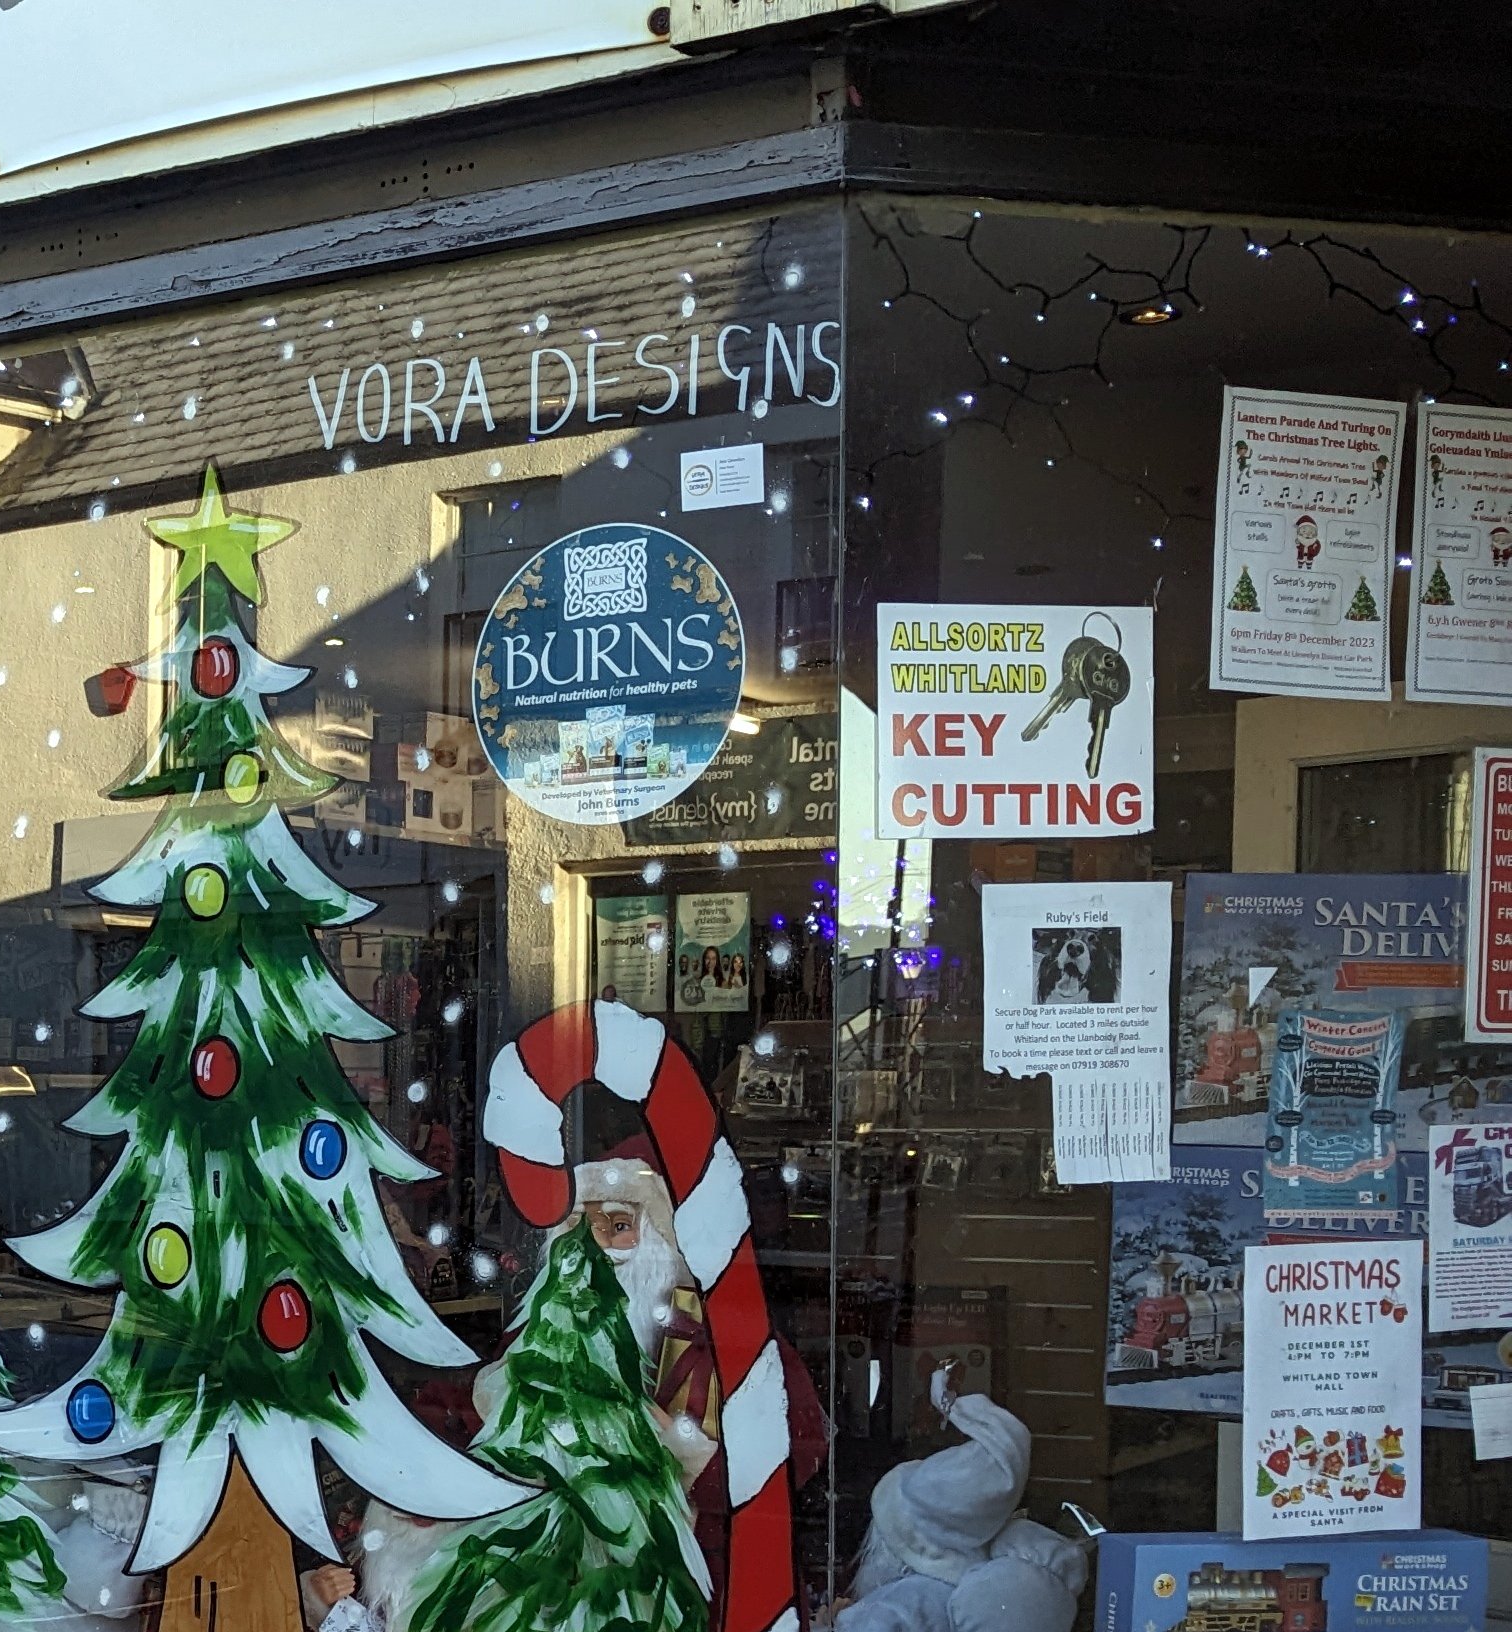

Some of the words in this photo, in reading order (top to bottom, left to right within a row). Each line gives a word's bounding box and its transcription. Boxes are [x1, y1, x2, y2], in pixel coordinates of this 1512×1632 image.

[308, 356, 495, 450] VORA
[529, 321, 842, 435] DESIGNS
[1237, 411, 1277, 425] Lantern
[1280, 416, 1315, 429] Parade
[1318, 420, 1338, 431] And
[1341, 421, 1375, 437] Turing
[1378, 425, 1391, 435] On
[1246, 429, 1265, 441] The
[1268, 432, 1319, 446] Christmas
[1321, 436, 1345, 448] Tree
[1347, 439, 1380, 452] Lights.
[1432, 427, 1490, 440] Gorymdaith
[1430, 443, 1482, 456] Goleuadau
[1273, 575, 1306, 587] Santa's
[1307, 580, 1337, 591] grotto
[1468, 574, 1492, 586] Groto
[1452, 616, 1487, 628] Gwener
[891, 621, 1044, 653] ALLSORTZ
[1230, 627, 1251, 639] 6pm
[1253, 629, 1282, 643] Friday
[1299, 633, 1347, 647] December
[1349, 637, 1375, 648] 2023
[502, 613, 714, 689] BURNS
[1356, 655, 1373, 663] Park
[891, 664, 1047, 694] WHITLAND
[515, 691, 557, 706] Natural
[559, 687, 607, 702] nutrition
[608, 684, 625, 700] for
[626, 683, 669, 696] healthy
[671, 679, 698, 693] pets
[892, 713, 1007, 757] KEY
[583, 790, 592, 798] by
[634, 784, 665, 793] Surgeon
[577, 799, 603, 813] John
[606, 798, 639, 810] Burns
[892, 783, 1142, 827] CUTTING
[1224, 896, 1304, 908] CHRISTMAS
[1046, 912, 1080, 925] Ruby's
[1083, 911, 1109, 923] Field
[1225, 907, 1303, 916] workshop
[1314, 897, 1466, 928] SANTA'S
[995, 1008, 1021, 1017] Secure
[1023, 1008, 1038, 1018] Dog
[1040, 1007, 1056, 1016] Park
[1059, 1006, 1094, 1015] available
[1107, 1006, 1123, 1014] rent
[1126, 1006, 1139, 1015] per
[1141, 1005, 1158, 1013] hour
[1016, 1020, 1030, 1029] half
[1032, 1020, 1052, 1029] hour.
[1056, 1020, 1087, 1028] Located
[1090, 1020, 1095, 1028] 3
[1097, 1019, 1118, 1028] miles
[1120, 1019, 1149, 1027] outside
[1308, 1021, 1345, 1036] Winter
[1349, 1021, 1386, 1035] Concert
[1014, 1035, 1048, 1044] Whitland
[1062, 1034, 1075, 1042] the
[1078, 1033, 1117, 1043] Llanboidy
[1119, 1033, 1141, 1041] Road.
[990, 1050, 999, 1058] To
[1002, 1049, 1021, 1058] book
[1030, 1048, 1047, 1057] time
[1049, 1048, 1073, 1058] please
[1076, 1048, 1092, 1056] text
[1104, 1047, 1118, 1055] call
[1120, 1046, 1135, 1055] and
[1138, 1046, 1157, 1054] leave
[1026, 1063, 1058, 1072] message
[1072, 1060, 1097, 1069] 07919
[1099, 1060, 1129, 1069] 308670
[1453, 1236, 1505, 1248] SATURDAY
[1266, 1259, 1401, 1293] CHRISTMAS
[1284, 1301, 1377, 1327] MARKET
[1288, 1341, 1345, 1350] DECEMBER
[1350, 1340, 1370, 1349] 1ST
[1321, 1352, 1335, 1360] TO
[1344, 1351, 1370, 1359] 7:PM
[1282, 1372, 1341, 1382] WHITLAND
[1346, 1371, 1378, 1380] TOWN
[1272, 1511, 1279, 1520] A
[1282, 1509, 1325, 1520] SPECIAL
[1329, 1507, 1355, 1517] VISIT
[1358, 1505, 1384, 1515] FROM
[1310, 1517, 1344, 1527] SANTA
[1395, 1555, 1447, 1563] CHRISTMAS
[1158, 1580, 1171, 1590] 3+
[1357, 1574, 1469, 1591] CHRISTMAS
[1428, 1593, 1462, 1611] SET
